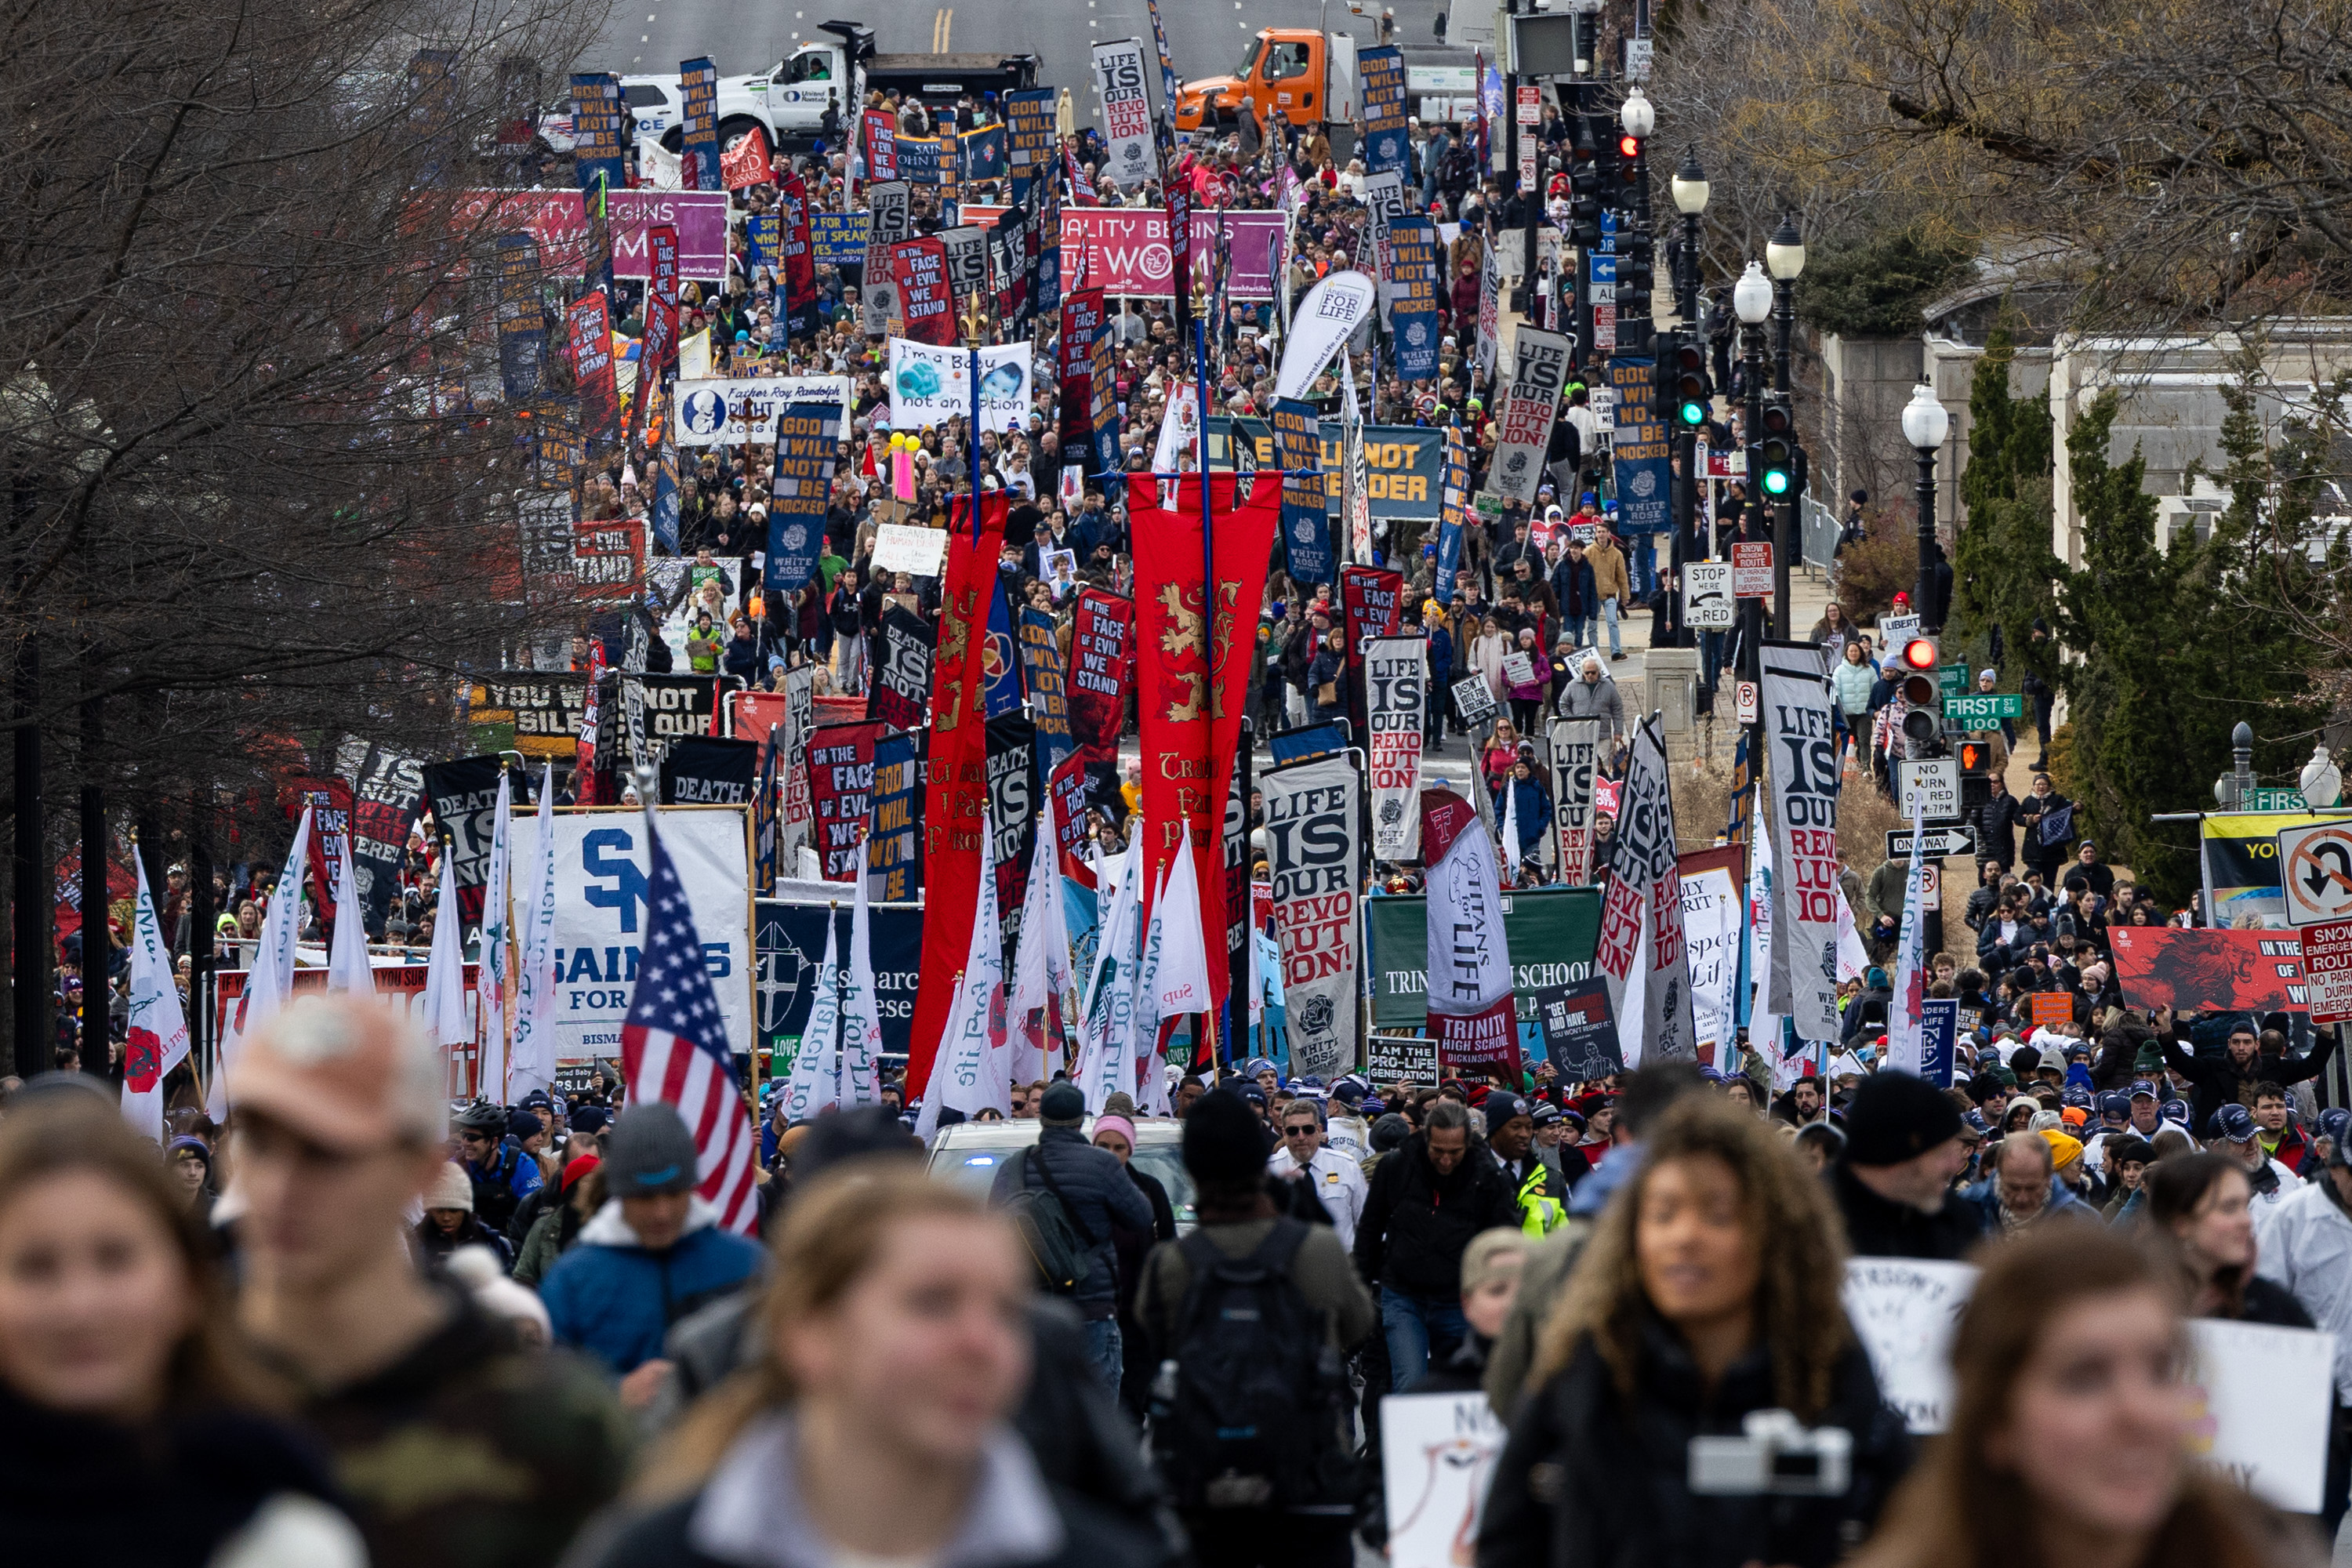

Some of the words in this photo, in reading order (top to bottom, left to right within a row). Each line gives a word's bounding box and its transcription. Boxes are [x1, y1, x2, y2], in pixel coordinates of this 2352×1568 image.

[1099, 53, 1136, 68] LIFE
[1360, 58, 1388, 74] GOD
[1102, 66, 1141, 90] IS
[1369, 71, 1403, 88] WILL
[1105, 88, 1143, 103] OUR
[1367, 87, 1395, 103] NOT
[1009, 101, 1039, 116] GOD
[1106, 99, 1145, 114] REVO
[1382, 102, 1401, 117] BE
[1018, 116, 1053, 132] WILL
[1109, 111, 1146, 127] LUT
[1368, 117, 1406, 132] MOCKED
[875, 127, 894, 142] FACE
[1110, 122, 1149, 140] ION!
[1014, 132, 1045, 148] NOT
[875, 154, 888, 165] WE
[1031, 148, 1051, 163] BE
[874, 194, 906, 208] LIFE
[821, 218, 841, 228] FOR
[873, 208, 906, 230] IS
[753, 233, 779, 244] WHO
[1392, 228, 1419, 245] GOD
[907, 247, 922, 256] THE
[1398, 247, 1433, 261] WILL
[910, 255, 940, 272] FACE
[949, 254, 985, 282] IS
[1395, 265, 1425, 280] NOT
[909, 287, 931, 302] WE
[1411, 282, 1432, 297] BE
[909, 299, 946, 318] STAND
[1325, 294, 1358, 310] FOR
[1395, 299, 1436, 314] MOCKED
[1075, 310, 1098, 328] FACE
[1319, 305, 1353, 321] LIFE
[1069, 345, 1084, 360] WE
[1519, 340, 1563, 362] LIFE
[1515, 357, 1559, 388] IS
[728, 387, 768, 398] Father
[771, 387, 792, 401] Roy
[794, 384, 840, 398] Randolph
[1512, 384, 1553, 404] OUR
[902, 395, 934, 408] not
[941, 398, 961, 408] an
[1510, 400, 1552, 418] REVO
[783, 417, 821, 436] GOD
[1275, 412, 1304, 431] GOD
[1506, 414, 1547, 431] LUT
[1502, 429, 1546, 448] ION!
[1640, 426, 1664, 442] BE
[790, 438, 834, 458] WILL
[1283, 433, 1320, 453] WILL
[1617, 444, 1668, 460] MOCKED
[782, 459, 822, 477] NOT
[799, 480, 826, 497] BE
[772, 499, 826, 515] MOCKED
[1283, 490, 1325, 509] MOCKED
[1624, 500, 1665, 510] WHITE
[1631, 510, 1661, 519] ROSE
[898, 528, 926, 539] STAND
[775, 557, 813, 566] WHITE
[1290, 548, 1325, 560] WHITE
[1294, 557, 1320, 568] ROSE
[779, 566, 806, 575] ROSE
[1693, 568, 1726, 581] STOP
[1362, 577, 1378, 588] THE
[1084, 597, 1093, 610] IN
[1094, 601, 1109, 615] THE
[1364, 589, 1395, 609] FACE
[1354, 608, 1364, 617] OF
[1703, 610, 1729, 621] RED
[1093, 616, 1124, 640] FACE
[1360, 622, 1383, 636] WE
[887, 624, 928, 659] DEATH
[1081, 633, 1091, 646] OF
[884, 639, 927, 684] IS
[1083, 652, 1106, 673] WE
[1371, 659, 1419, 677] LIFE
[880, 668, 926, 704] NOT
[1077, 670, 1119, 696] STAND
[1456, 675, 1483, 696] DON'T
[642, 688, 698, 710] NOT
[1371, 678, 1421, 713] IS
[1463, 696, 1491, 714] VIOLENCE
[1947, 699, 1999, 715] FIRST
[1372, 713, 1420, 731] OUR
[1776, 706, 1831, 738] LIFE
[1965, 719, 1999, 730] 100
[1372, 732, 1421, 750] REVO
[813, 748, 827, 765] IN
[829, 746, 854, 764] THE
[1372, 750, 1420, 768] LUT
[1780, 737, 1835, 793] IS
[1918, 764, 1938, 775] NO
[875, 764, 902, 796] GOD
[1063, 774, 1075, 791] THE
[1557, 765, 1592, 805] IS
[358, 779, 420, 810] NOT
[675, 776, 746, 804] DEATH
[1930, 791, 1953, 800] RED
[820, 800, 833, 817] OF
[989, 771, 1029, 835] IS
[1268, 785, 1346, 824] LIFE
[315, 809, 348, 832] FACE
[879, 797, 911, 833] WILL
[829, 823, 860, 846] WE
[1062, 826, 1070, 841] OF
[992, 822, 1027, 863] NOT
[1269, 812, 1349, 876] IS
[1926, 837, 1947, 849] WAY
[868, 835, 902, 868] NOT
[887, 871, 906, 897] BE
[1273, 866, 1350, 903] OUR
[1275, 891, 1352, 929] REVO
[1461, 895, 1472, 920] for
[1468, 876, 1490, 967] TITANS
[1279, 916, 1351, 962] LUT
[2263, 942, 2274, 956] IN
[2278, 942, 2301, 956] THE
[1283, 943, 1352, 989] ION!
[1452, 923, 1480, 1001] LIFE
[2278, 964, 2294, 978] OF
[222, 975, 234, 992] IF
[381, 970, 401, 986] YOU
[2310, 974, 2325, 986] NO
[570, 990, 628, 1009] FOR
[1443, 1013, 1506, 1039] TRINITY
[1549, 1016, 1565, 1032] AND
[1566, 1011, 1587, 1028] HAVE
[1583, 1023, 1602, 1033] REGRET
[774, 1039, 797, 1057] LOVE
[1298, 1036, 1339, 1058] WHITE
[1381, 1047, 1402, 1055] AM
[1406, 1047, 1431, 1056] THE
[1442, 1039, 1472, 1051] HIGH
[1167, 1047, 1185, 1063] LOVE
[1305, 1050, 1334, 1066] ROSE
[1370, 1056, 1435, 1069] PRO-LIFE
[1447, 1053, 1497, 1063] DICKINSON,
[575, 1069, 592, 1078] Baby
[1371, 1069, 1434, 1080] GENERATION
